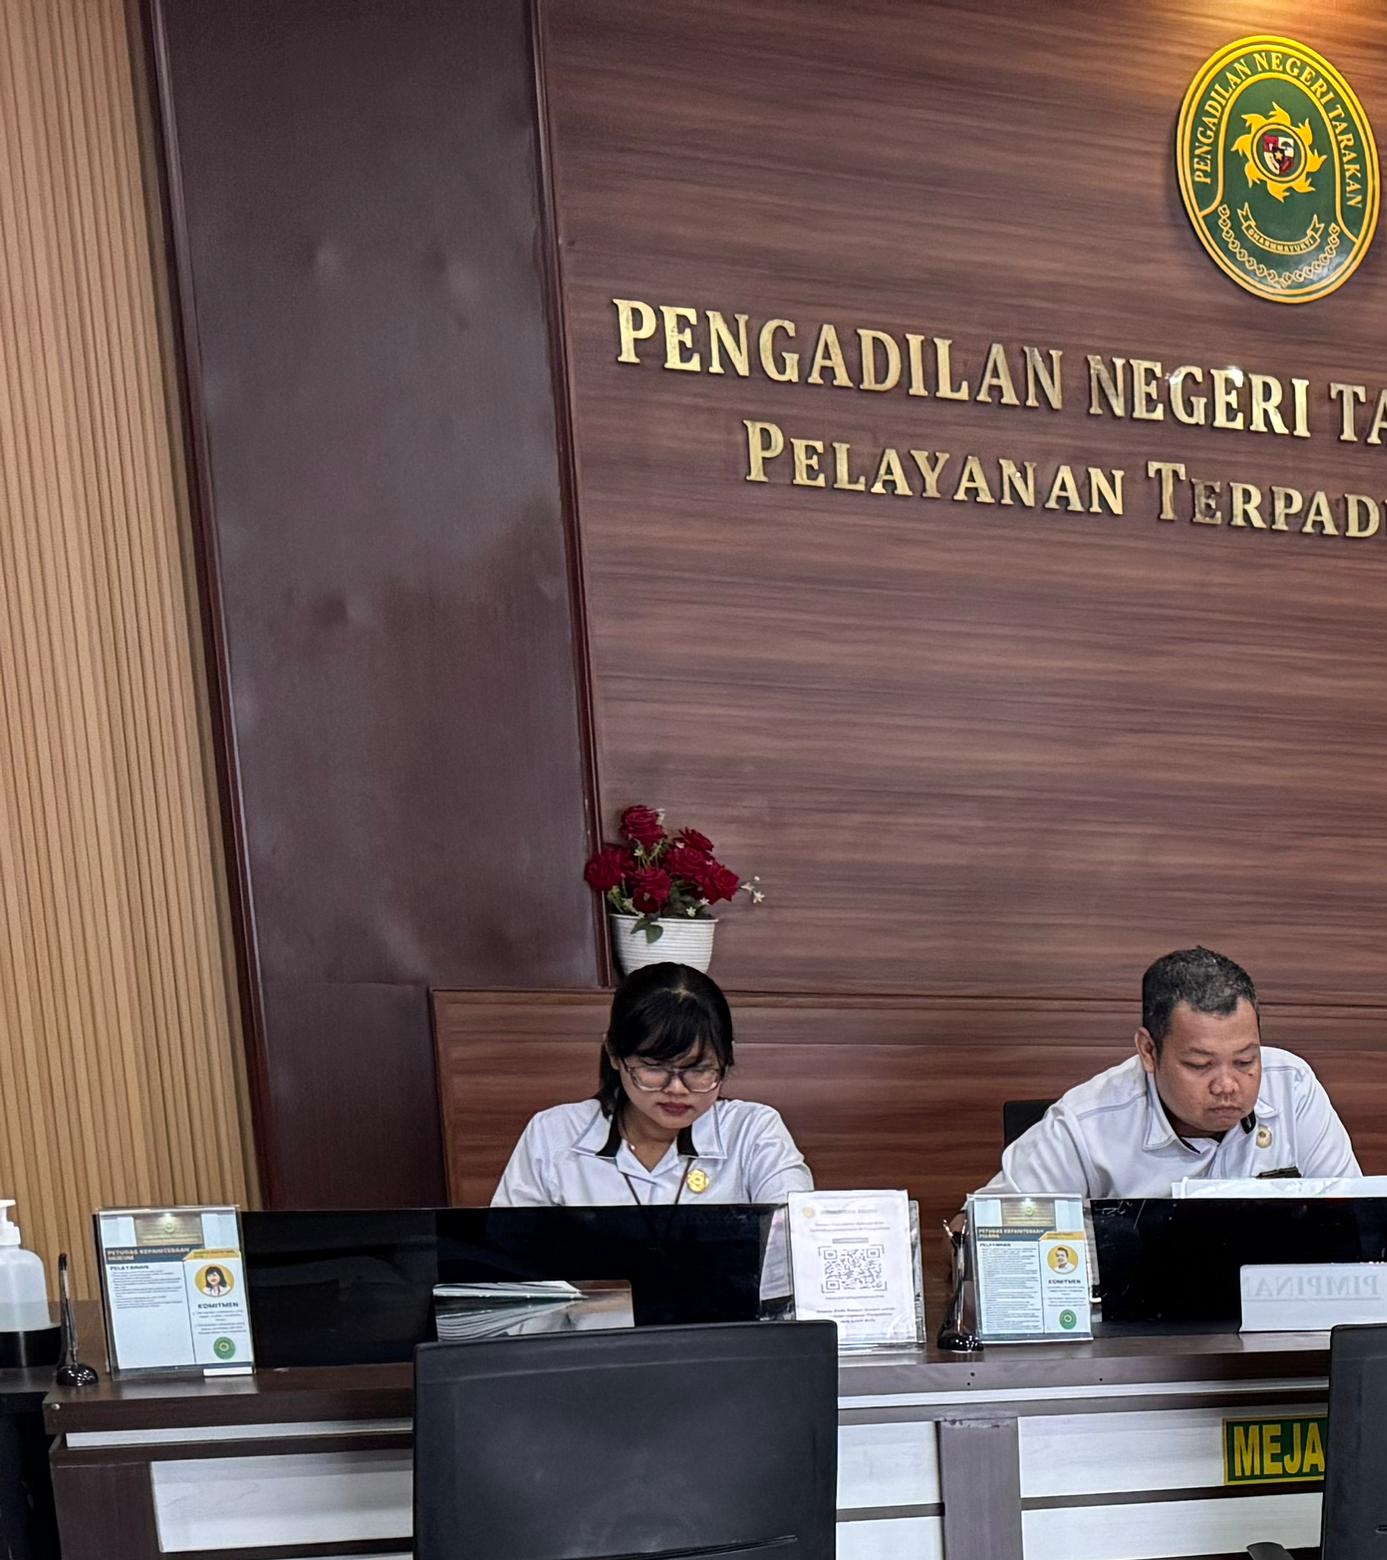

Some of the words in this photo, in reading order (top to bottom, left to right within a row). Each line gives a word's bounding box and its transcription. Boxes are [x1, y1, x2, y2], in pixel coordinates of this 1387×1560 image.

[1194, 58, 1253, 184] PENGADILAN
[1253, 52, 1334, 105] NEGERI
[1328, 105, 1363, 208] TARAKAN
[612, 298, 1062, 410] PENGADILAN
[1086, 354, 1311, 438] NEGERI
[743, 419, 1123, 515] PELAYANAN
[1234, 1422, 1325, 1477] MEJA
